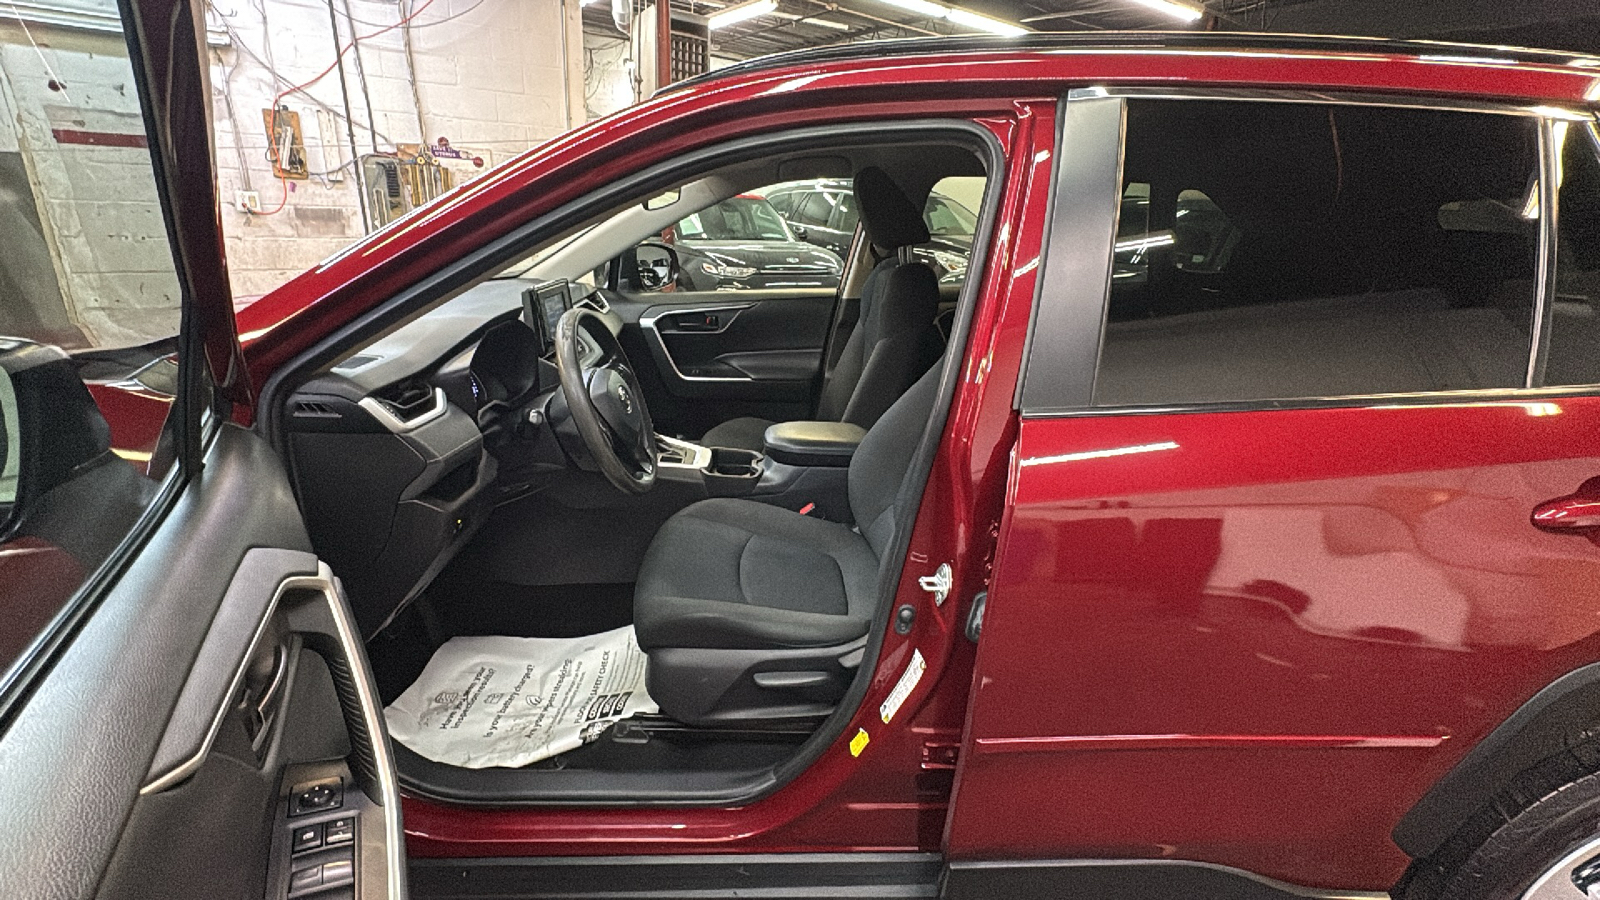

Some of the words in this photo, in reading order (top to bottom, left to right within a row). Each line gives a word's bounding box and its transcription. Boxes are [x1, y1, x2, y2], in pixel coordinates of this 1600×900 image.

[597, 650, 611, 675] CHECK
[473, 666, 487, 683] your
[513, 664, 536, 693] charged?
[496, 690, 519, 717] battery
[489, 712, 505, 731] your
[533, 711, 547, 728] your
